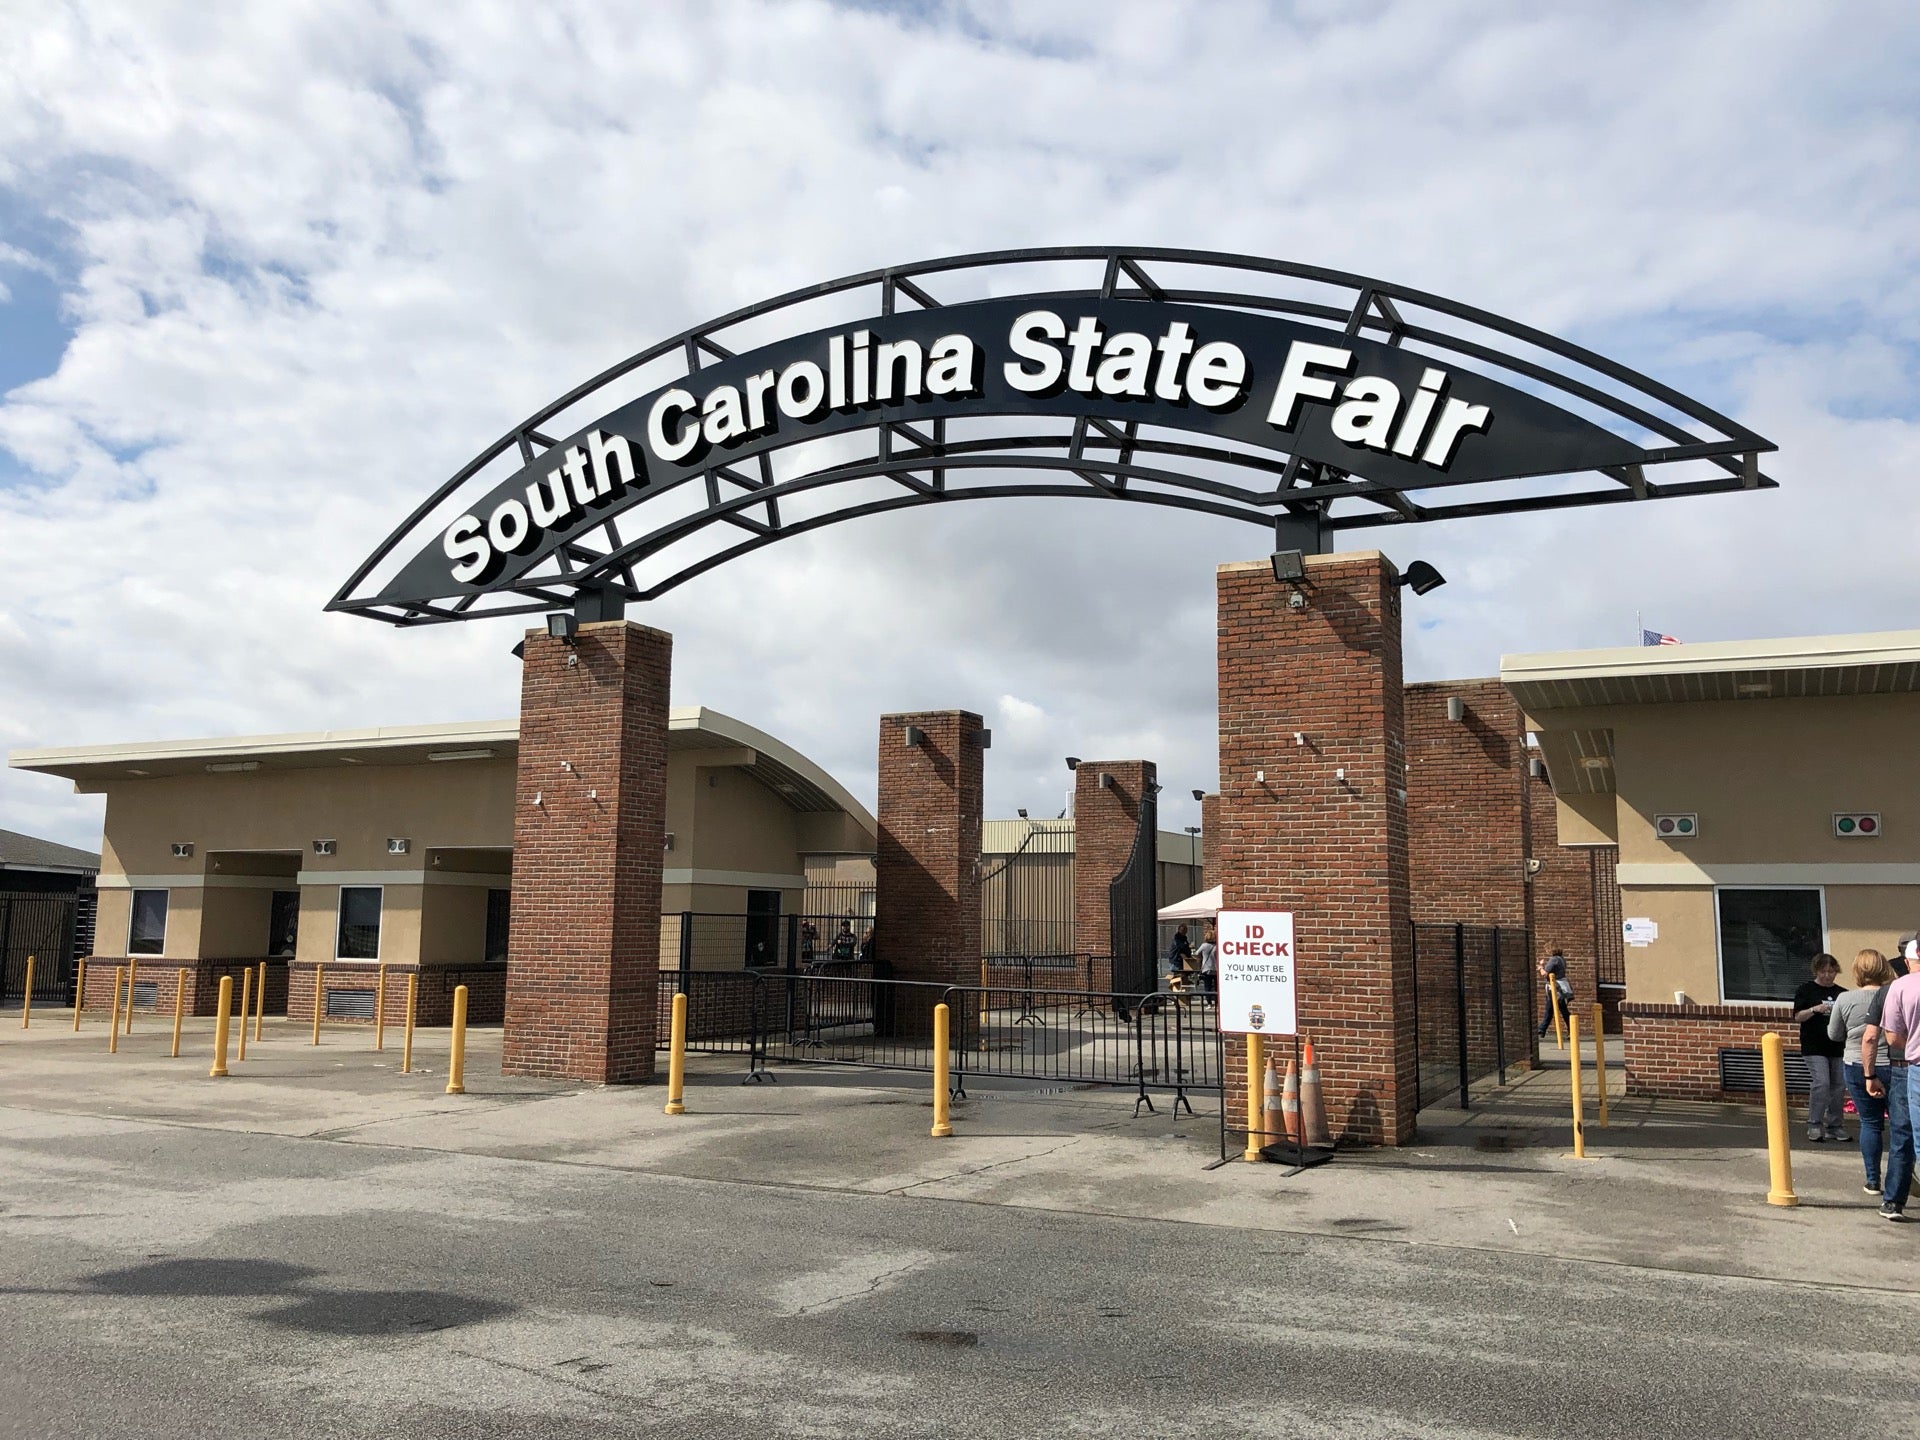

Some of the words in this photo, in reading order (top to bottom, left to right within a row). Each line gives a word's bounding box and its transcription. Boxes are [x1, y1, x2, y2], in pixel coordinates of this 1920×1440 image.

[442, 428, 637, 583] South
[647, 329, 974, 462] Carolina
[1003, 310, 1246, 407] State
[1265, 339, 1492, 467] Fair
[1245, 925, 1265, 939] ID
[1222, 941, 1290, 957] CHECK
[1227, 963, 1245, 972] YOU
[1246, 964, 1271, 973] MUST
[1272, 965, 1285, 973] BE
[1224, 973, 1239, 981] 21+
[1241, 974, 1252, 982] TO
[1253, 974, 1288, 983] ATTEND
